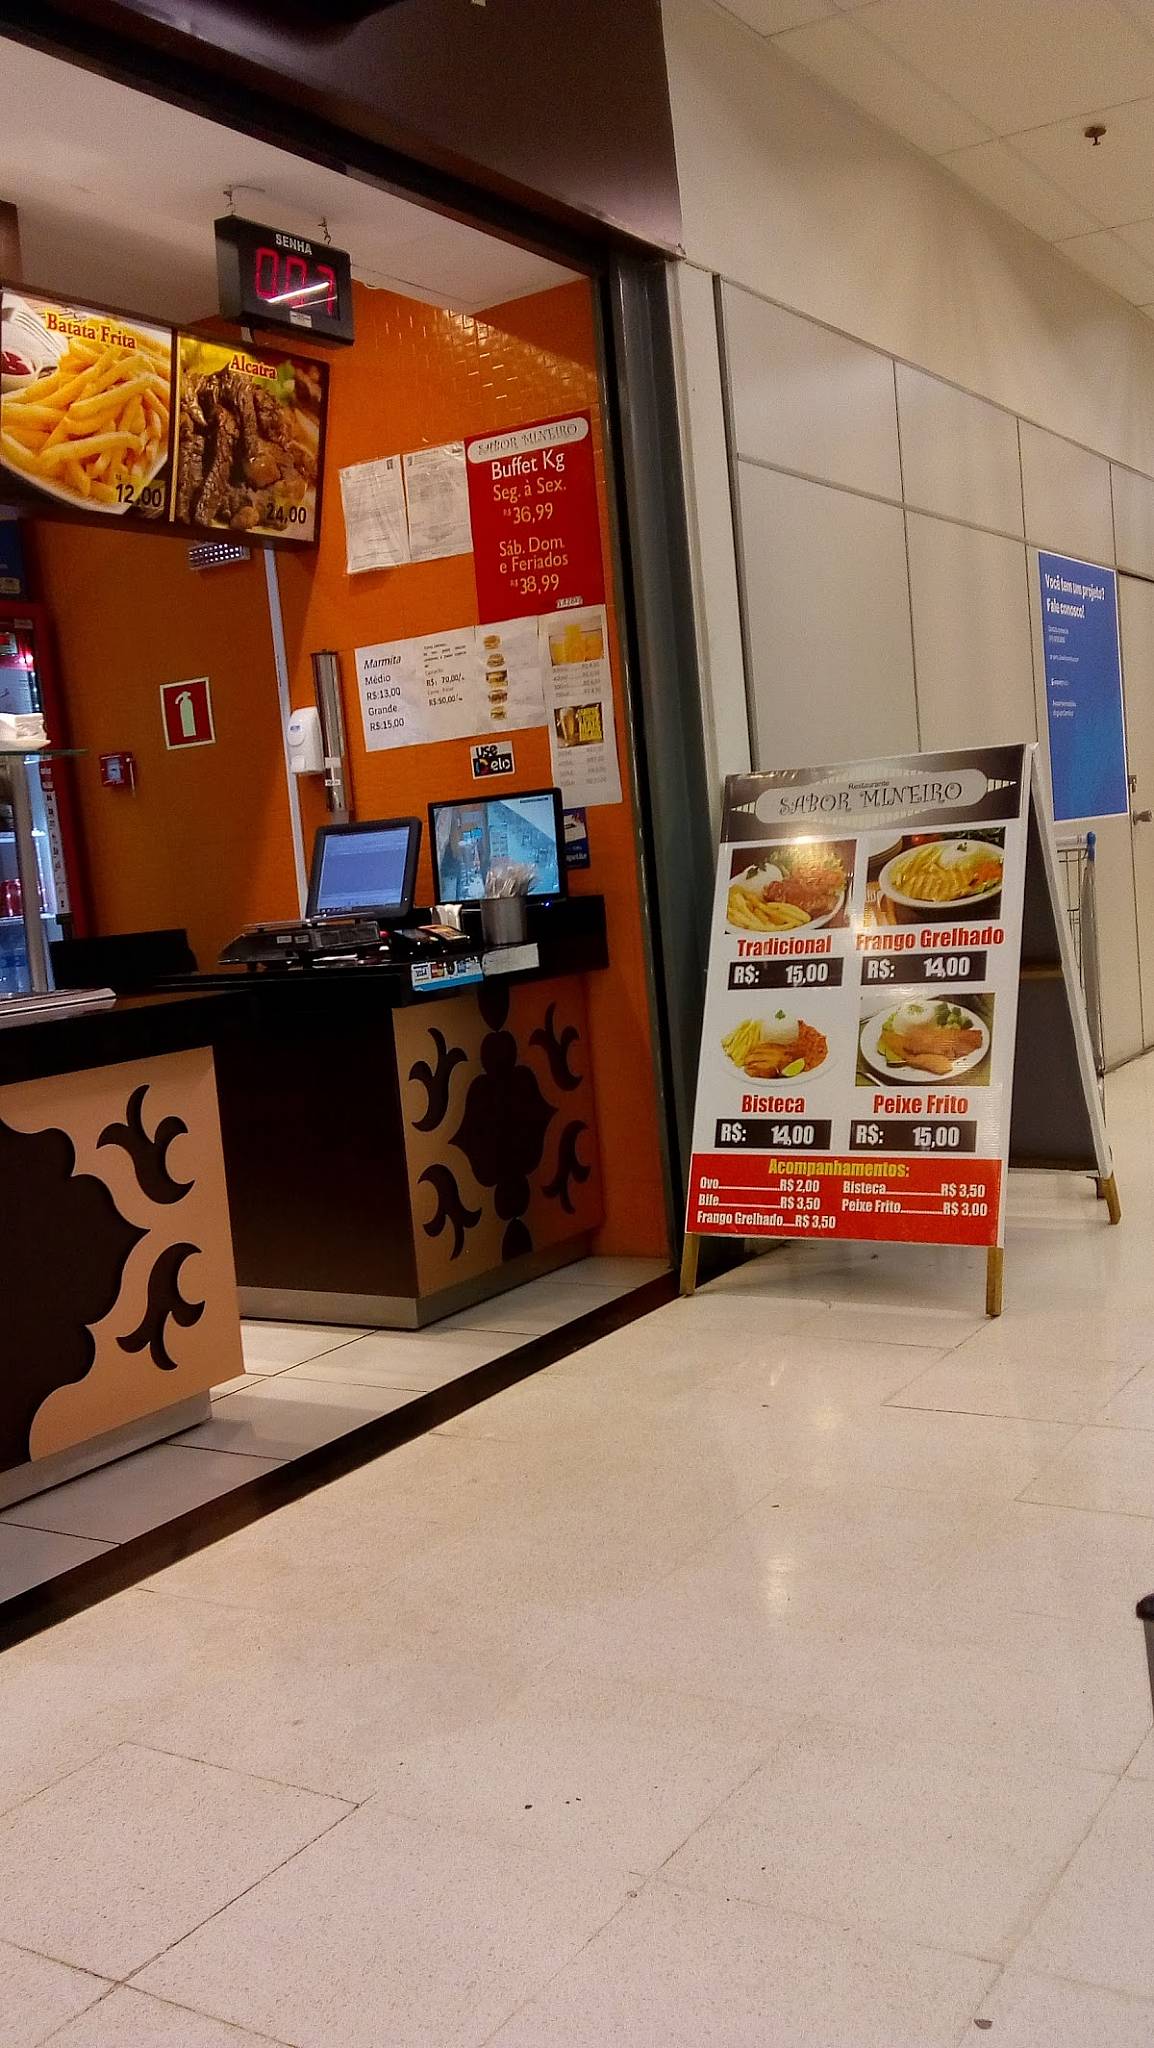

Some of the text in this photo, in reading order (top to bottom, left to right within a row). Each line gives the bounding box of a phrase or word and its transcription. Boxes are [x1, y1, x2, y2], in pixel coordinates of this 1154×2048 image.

[275, 233, 312, 256] SENHA
[47, 313, 137, 349] Batata Frita
[231, 354, 277, 379] Alcatra
[491, 449, 565, 480] Buffet Kg
[116, 483, 162, 508] 12,00
[493, 484, 521, 504] Seg.
[537, 477, 567, 494] Sex.
[266, 502, 307, 524] 24,00
[513, 502, 553, 524] 36,99
[499, 539, 526, 557] Sáb.
[499, 551, 569, 574] e Feriados
[520, 573, 560, 595] 38,99
[1045, 573, 1061, 590] Você
[1061, 577, 1073, 593] tem
[1082, 584, 1105, 601] projeto?
[1046, 598, 1060, 613] Fale
[363, 655, 402, 669] Marmita
[365, 674, 391, 686] Médio
[368, 703, 398, 716] Grande
[475, 744, 498, 759] use
[490, 757, 511, 771] elo
[779, 782, 963, 815] SABOR MINEIRO
[737, 935, 832, 957] Tradicional
[855, 926, 1005, 952] Frango Grelhado
[733, 962, 829, 985] R$: 15,00
[867, 956, 971, 979] R$: 14,00
[741, 1094, 806, 1113] Bisteca
[873, 1094, 969, 1114] Peixe Frito
[720, 1123, 815, 1145] R$: 14,00
[856, 1125, 960, 1148] R$: 15,00
[768, 1158, 910, 1177] Acompanhamentos:
[700, 1176, 719, 1189] Ovo
[796, 1180, 820, 1193] 2,00
[843, 1180, 887, 1194] Bisteca
[959, 1184, 986, 1198] 3,50
[698, 1193, 720, 1207] Bife
[796, 1197, 821, 1210] 3,50
[841, 1198, 873, 1212] Peixe
[875, 1199, 902, 1213] Frito
[697, 1210, 733, 1226] Frango
[734, 1211, 784, 1226] Grelhado
[811, 1215, 837, 1229] 3,50
